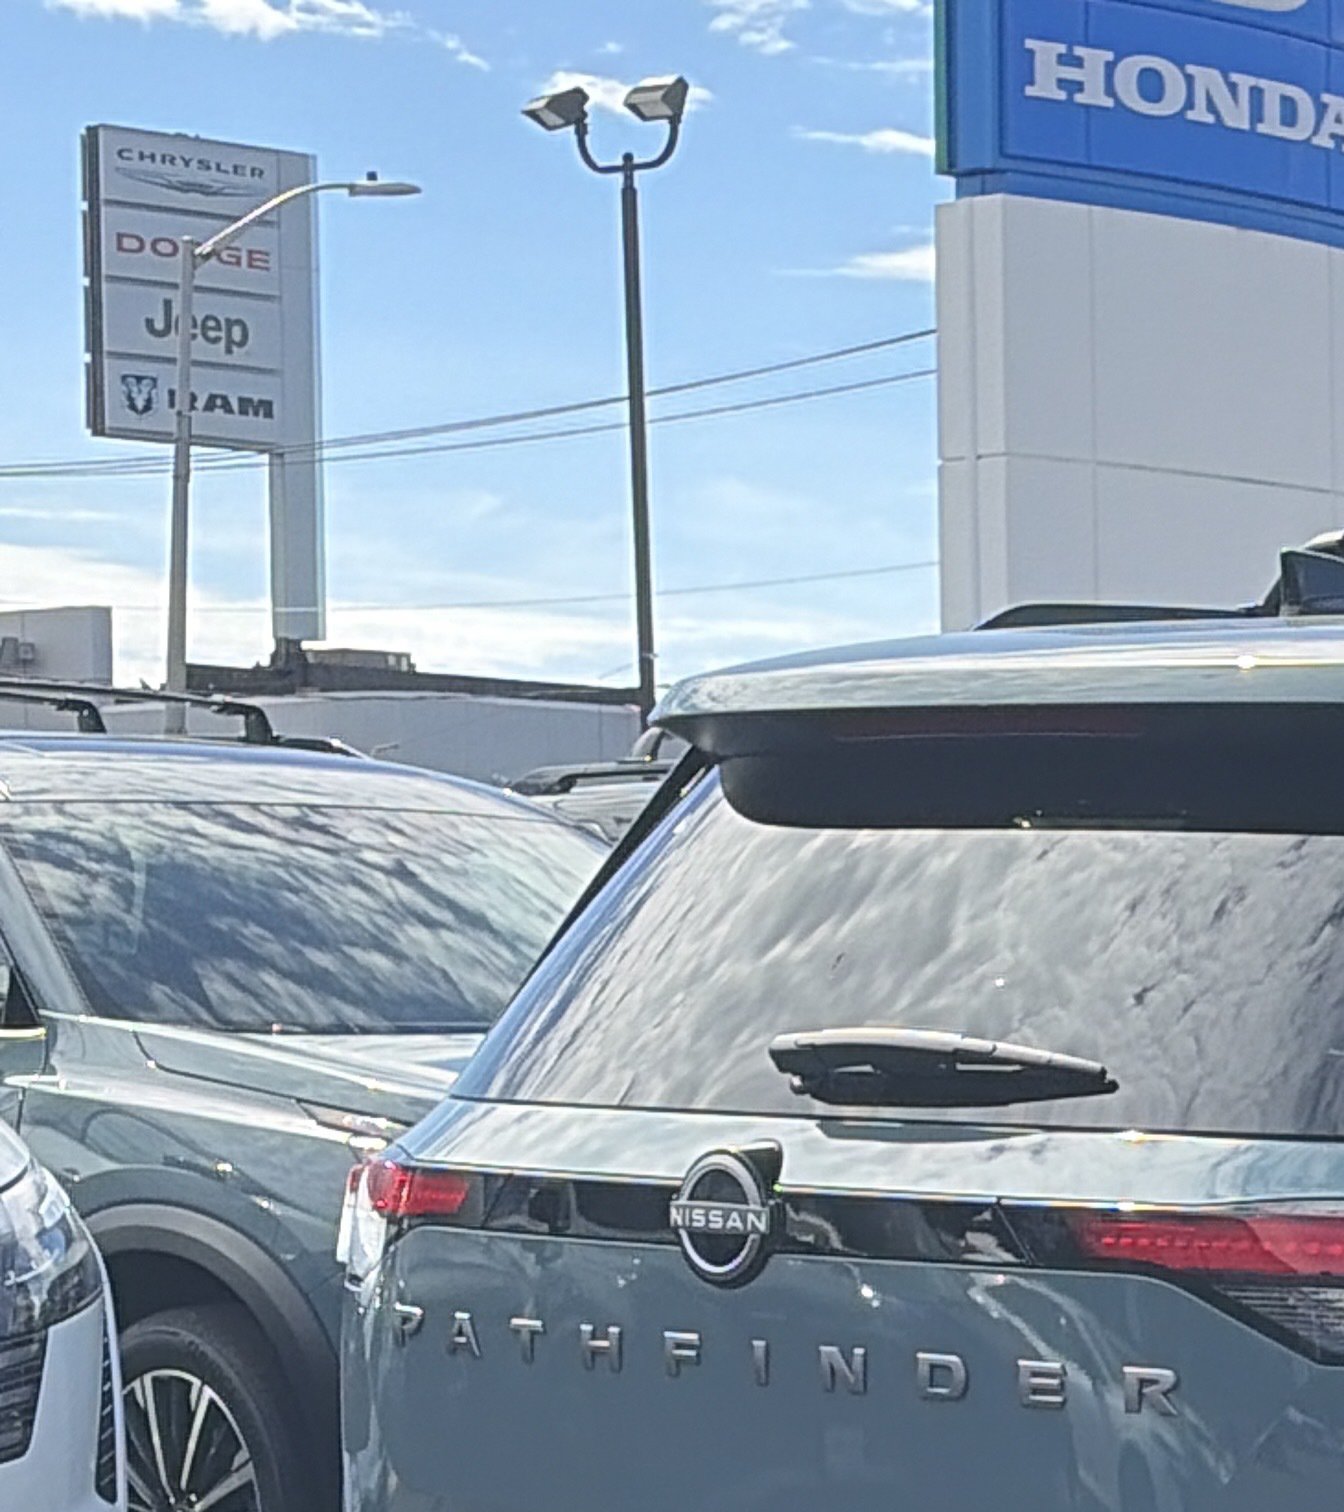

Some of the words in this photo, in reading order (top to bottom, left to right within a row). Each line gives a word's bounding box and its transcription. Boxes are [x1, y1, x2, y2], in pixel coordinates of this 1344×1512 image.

[116, 148, 266, 180] CHRYSLER
[115, 231, 272, 271] DOGE
[669, 1206, 768, 1234] NISSAN
[394, 1303, 1181, 1417] PATHFINDER
